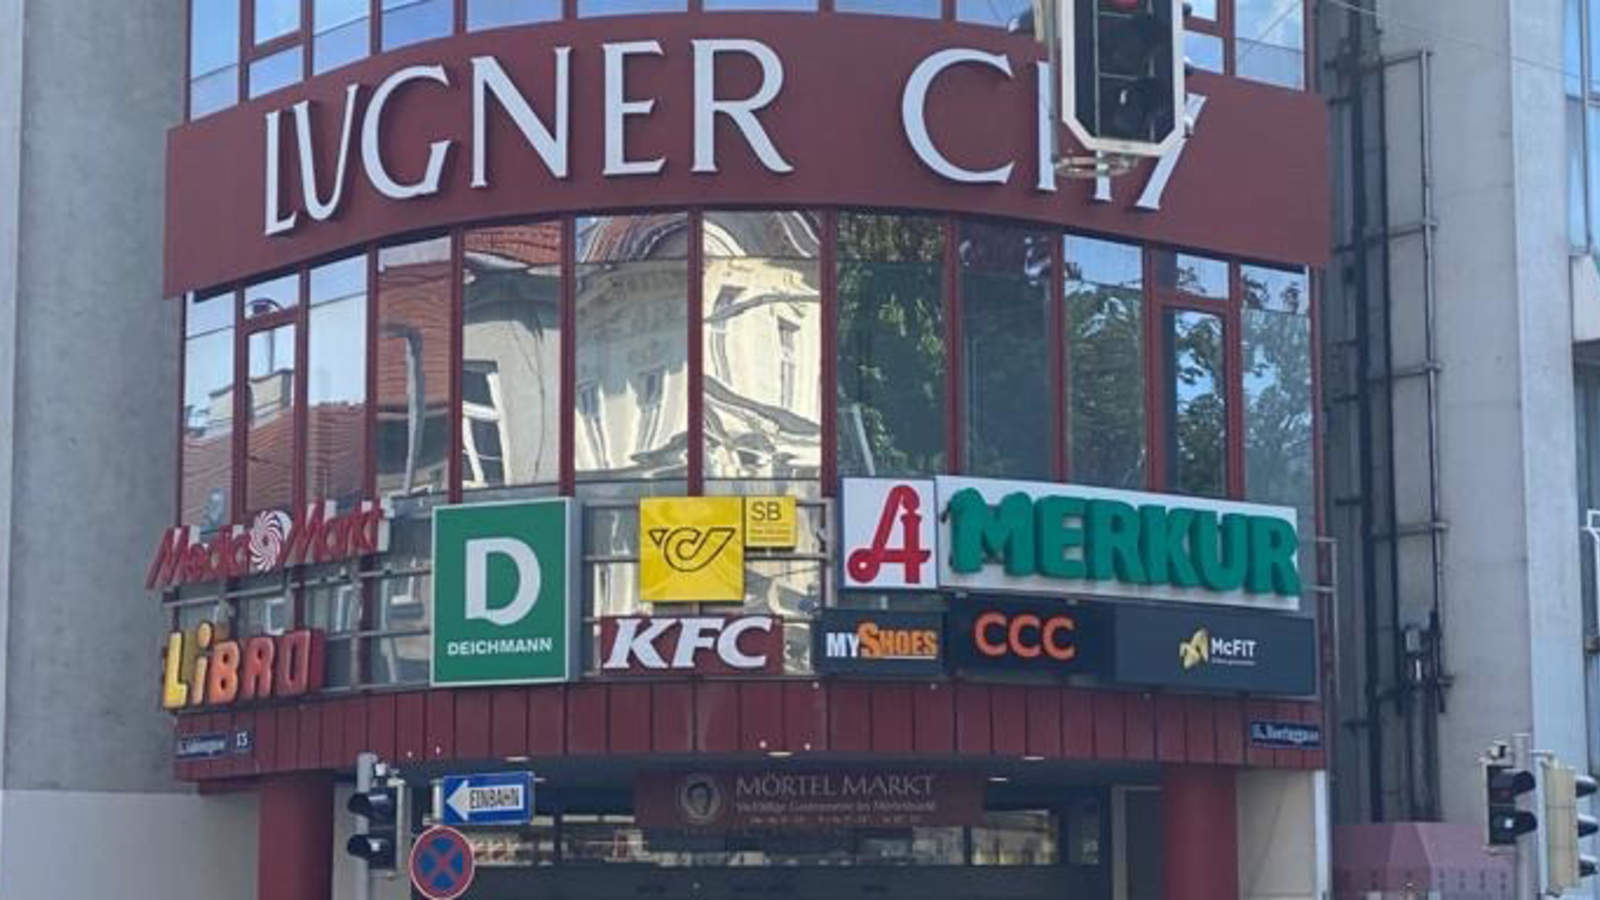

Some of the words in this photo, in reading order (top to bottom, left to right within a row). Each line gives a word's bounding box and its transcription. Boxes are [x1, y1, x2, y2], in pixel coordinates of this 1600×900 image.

[264, 37, 794, 236] LUGNER
[902, 48, 1207, 210] CIY
[750, 501, 782, 521] SB
[946, 487, 1298, 596] MERKUR
[464, 537, 541, 626] D
[447, 637, 553, 656] DEICHMANN
[603, 616, 773, 669] KFC
[974, 611, 1075, 660] CCC
[1211, 637, 1257, 657] McFIT
[469, 788, 520, 809] EINBAHN
[736, 772, 838, 797] MÖRTEL
[842, 774, 936, 796] MARKT
